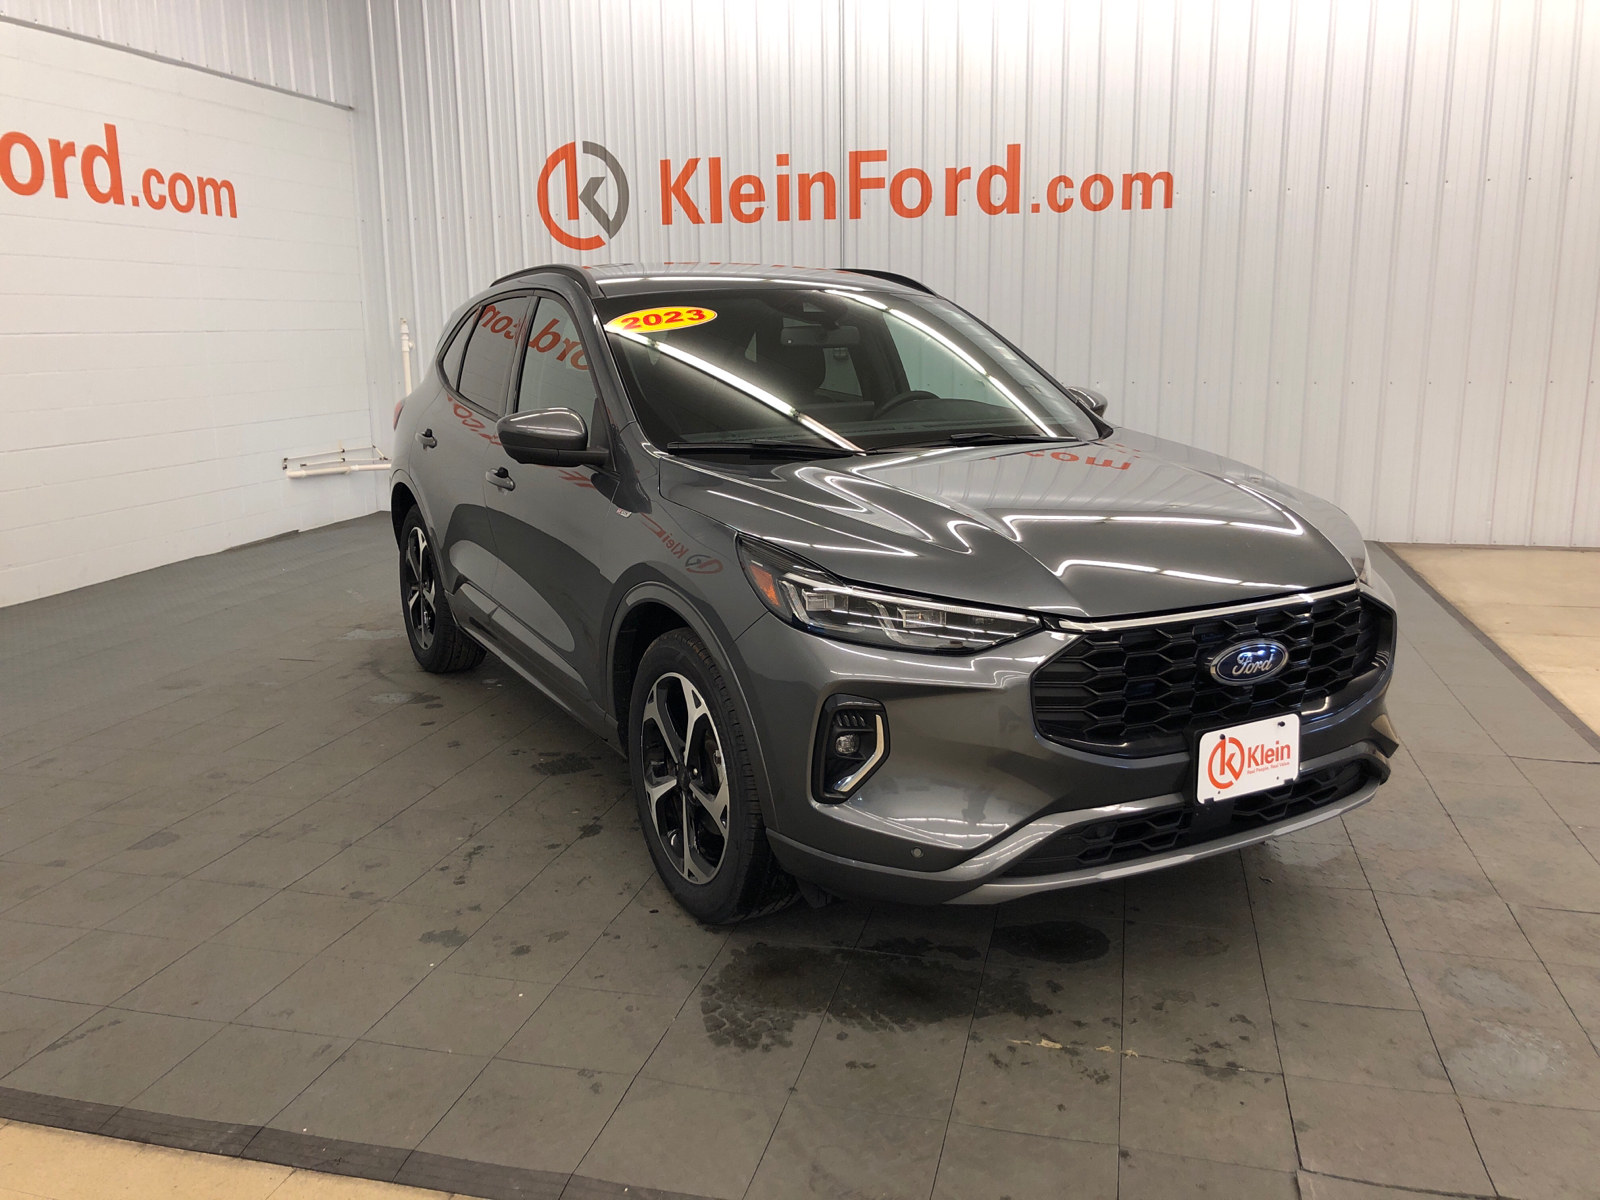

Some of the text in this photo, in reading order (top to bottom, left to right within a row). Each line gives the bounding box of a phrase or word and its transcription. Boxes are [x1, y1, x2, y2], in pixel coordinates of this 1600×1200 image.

[660, 144, 1173, 225] KleinFord.com
[620, 309, 706, 330] 2023
[1232, 650, 1273, 676] Ford
[1247, 740, 1291, 768] Klein
